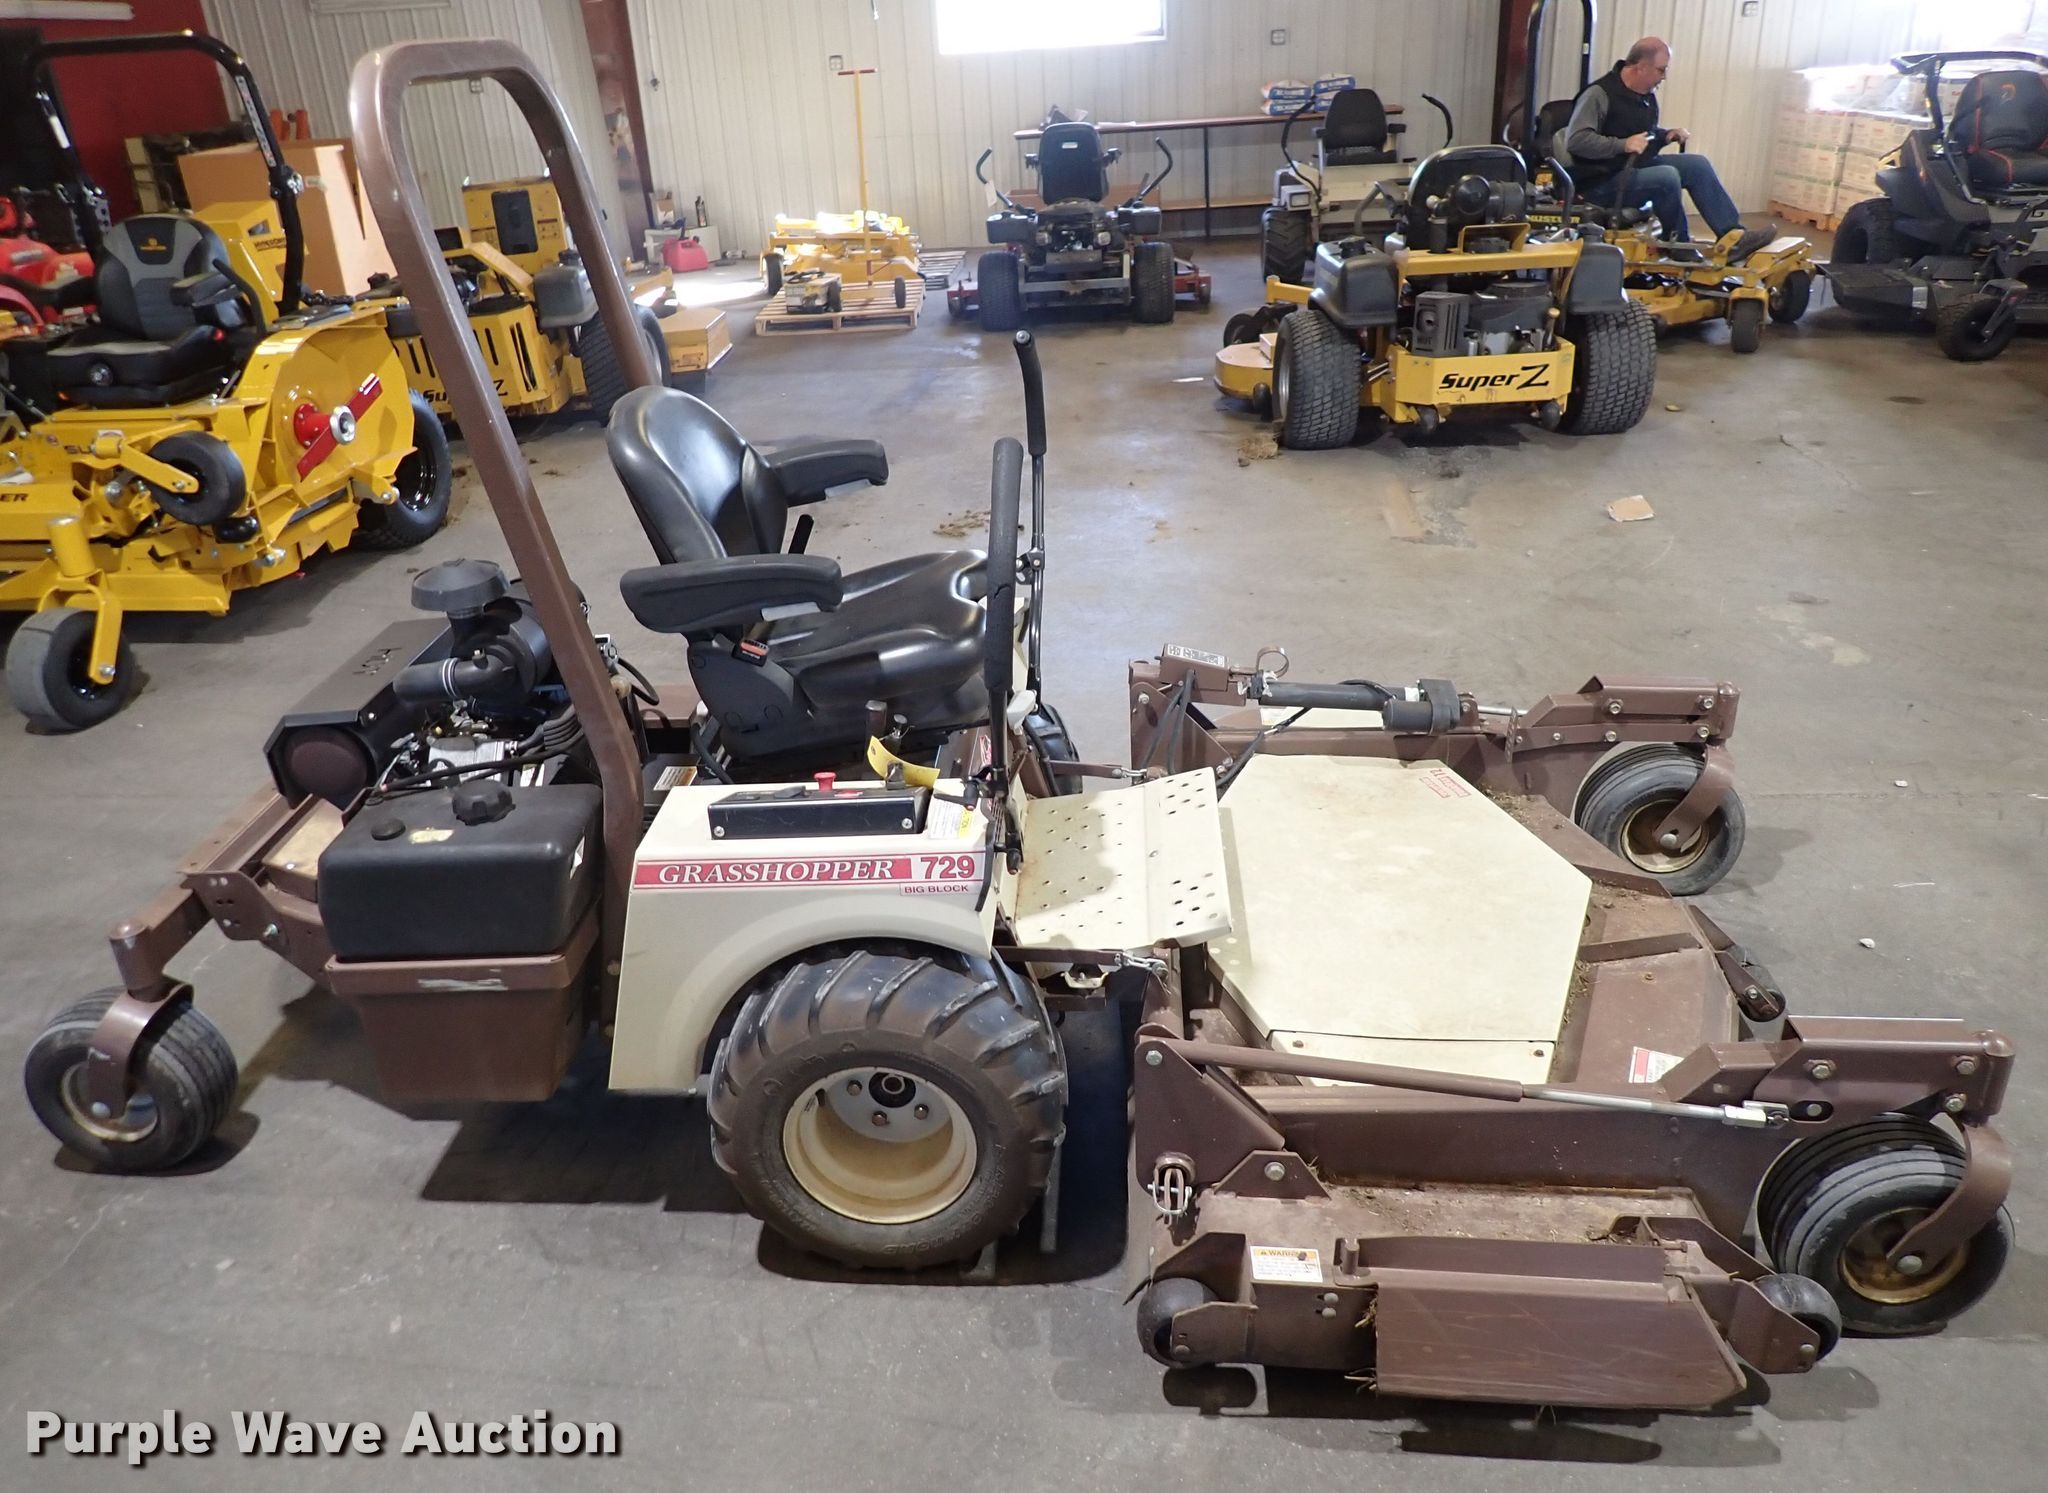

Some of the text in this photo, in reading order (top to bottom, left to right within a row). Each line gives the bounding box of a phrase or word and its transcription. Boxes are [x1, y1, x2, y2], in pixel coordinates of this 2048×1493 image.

[659, 855, 975, 884] GRASSHOPPER 729
[904, 885, 968, 894] BIG BLOCK
